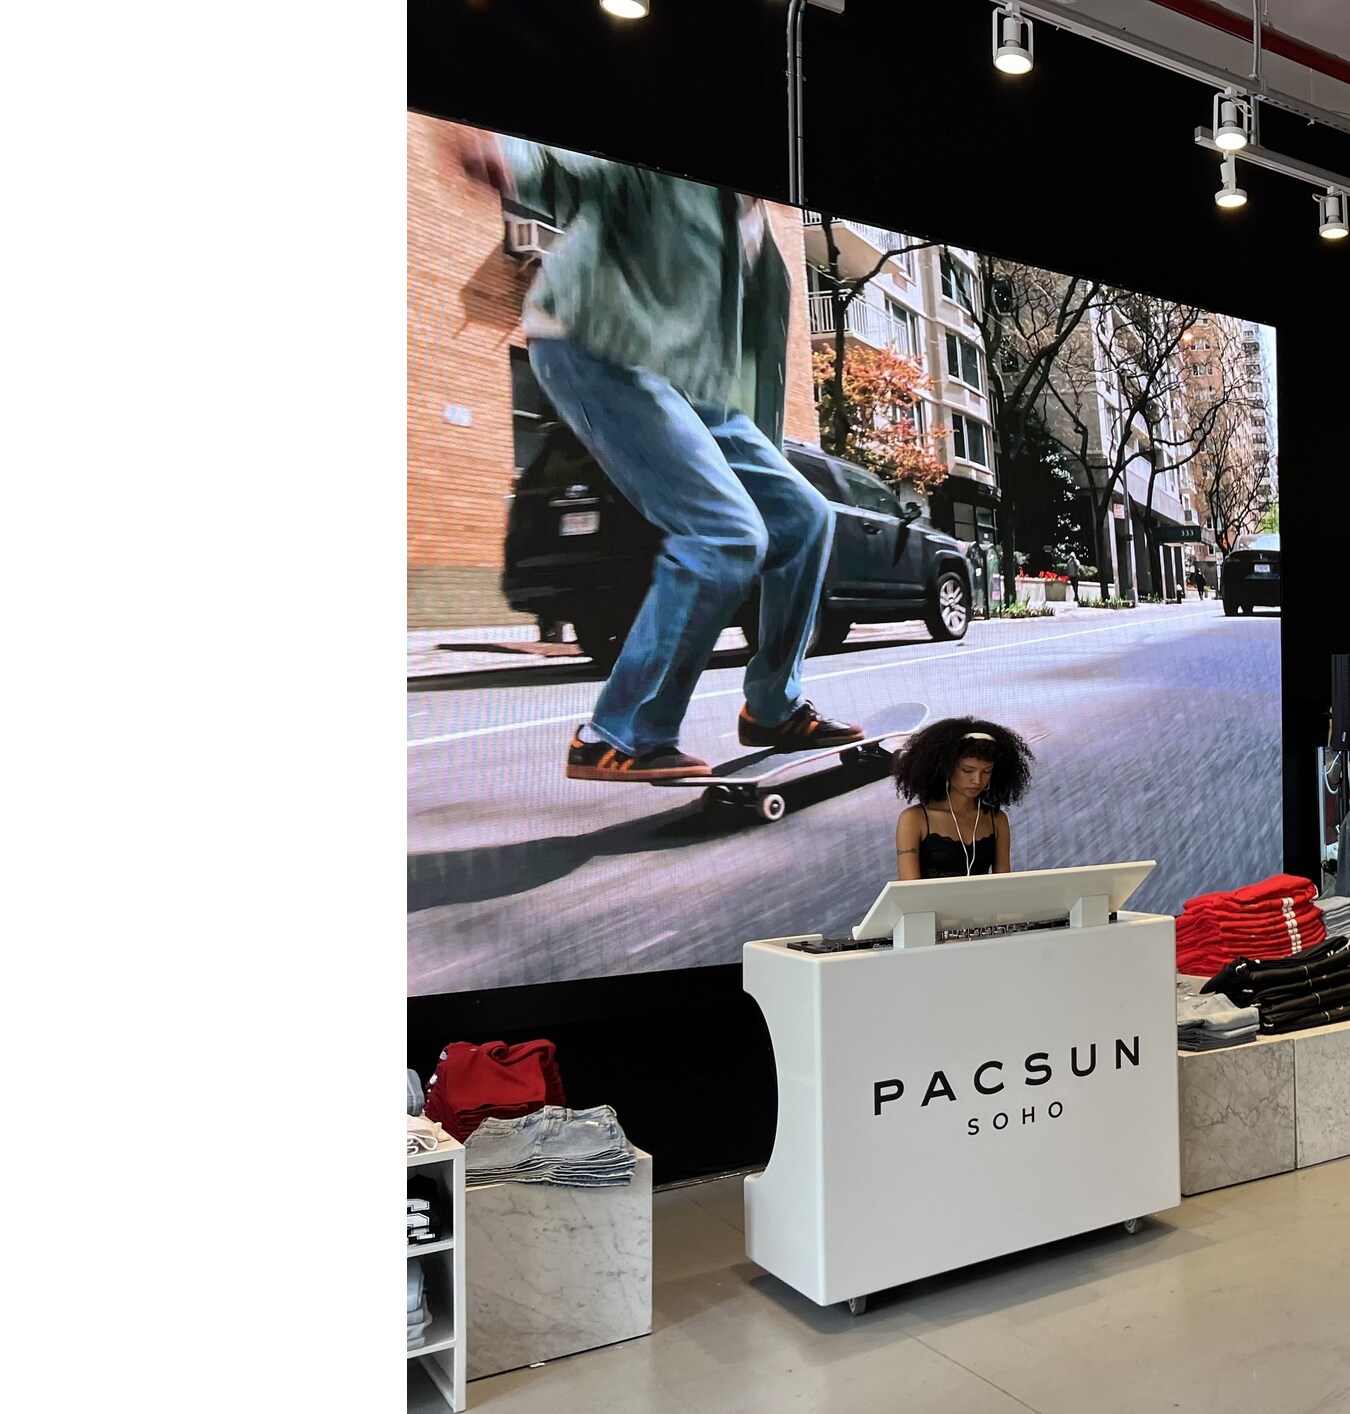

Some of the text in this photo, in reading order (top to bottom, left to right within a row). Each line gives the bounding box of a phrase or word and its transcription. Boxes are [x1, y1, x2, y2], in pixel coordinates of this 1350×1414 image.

[1181, 529, 1194, 537] 333
[874, 1036, 1140, 1116] PACSUN
[967, 1101, 1063, 1136] SOHO
